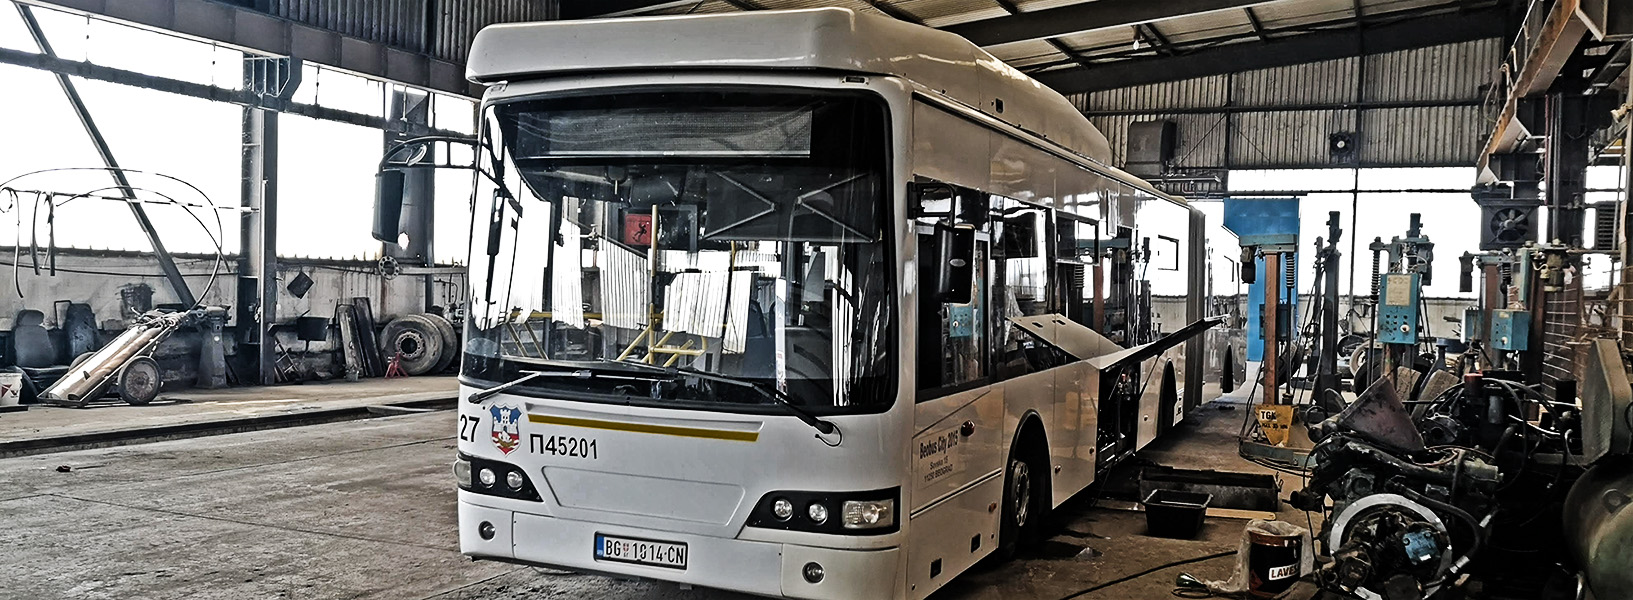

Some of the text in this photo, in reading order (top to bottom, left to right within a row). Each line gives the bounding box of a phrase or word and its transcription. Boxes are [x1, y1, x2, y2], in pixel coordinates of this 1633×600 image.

[460, 414, 480, 442] 27
[530, 433, 597, 459] П45201
[920, 430, 958, 459] Beobus City 2015
[934, 463, 953, 478] BEOGRAD
[606, 540, 621, 556] BG
